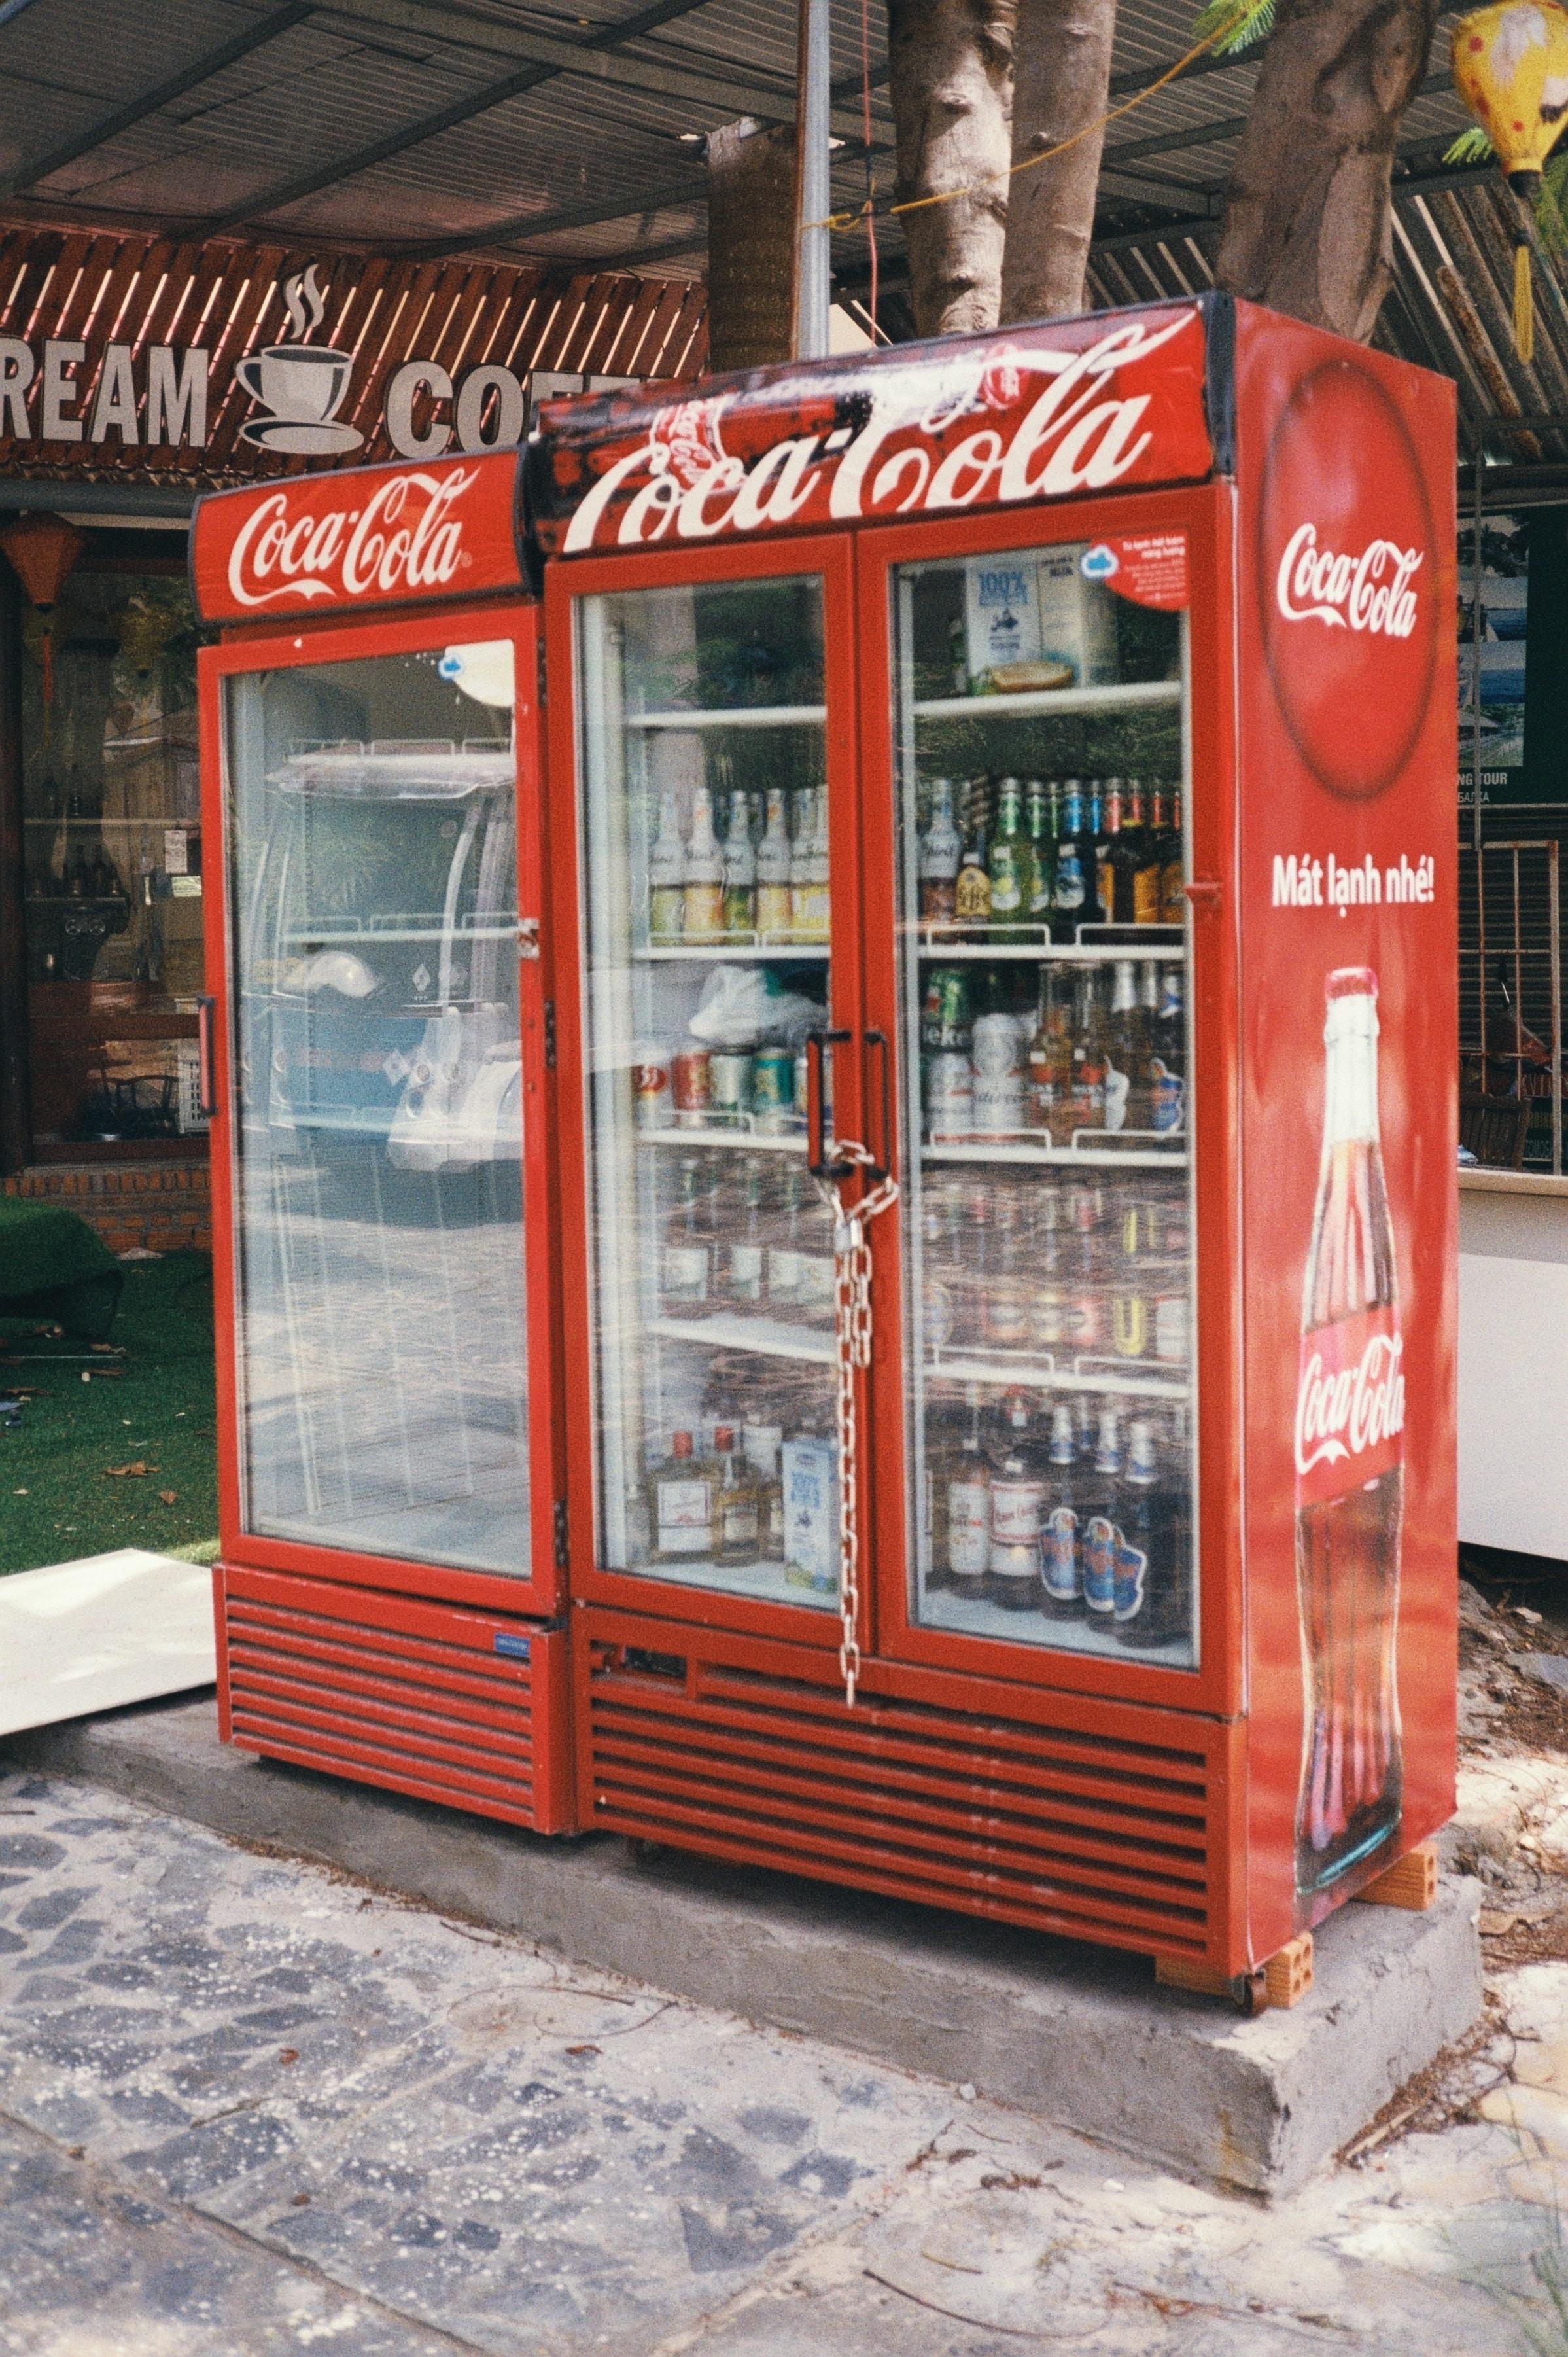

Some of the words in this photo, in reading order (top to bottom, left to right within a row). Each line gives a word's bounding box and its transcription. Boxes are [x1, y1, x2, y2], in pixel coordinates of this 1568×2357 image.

[564, 306, 1200, 554] Coca-Cola
[228, 465, 482, 606] Coca-Cola
[1277, 523, 1425, 639] Coca-Cola
[1272, 853, 1324, 906] Mát
[1328, 853, 1382, 918] lạnh
[1385, 853, 1435, 904] nhé!
[1294, 1331, 1406, 1475] Coca-Cola
